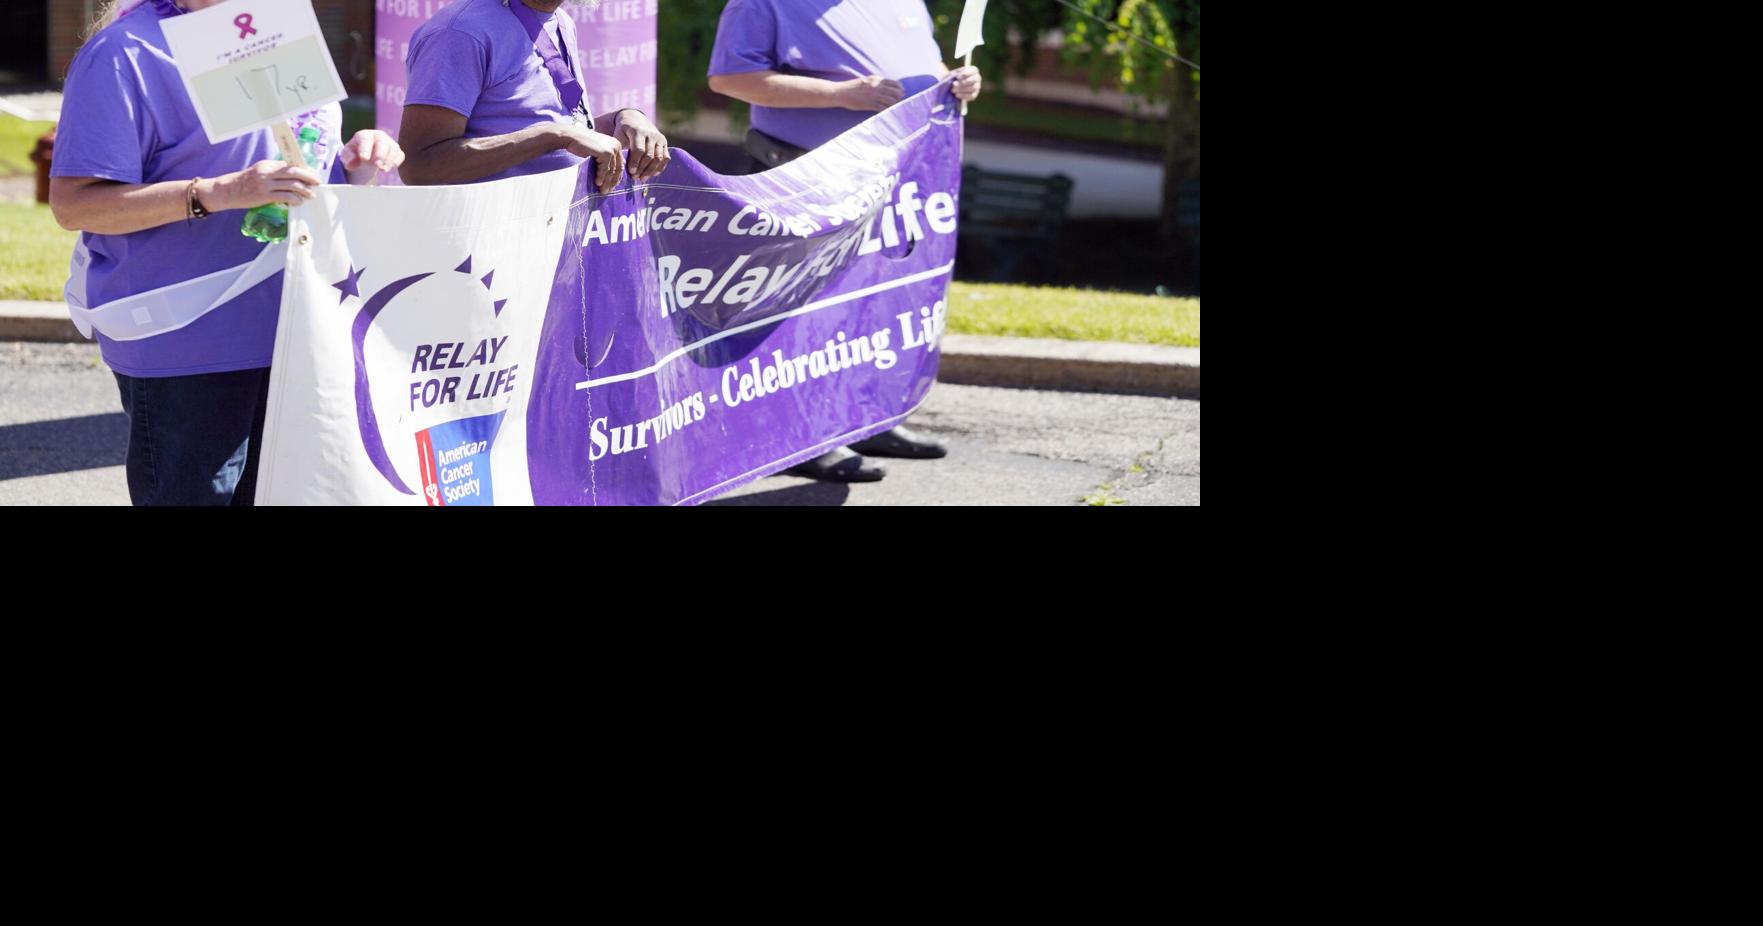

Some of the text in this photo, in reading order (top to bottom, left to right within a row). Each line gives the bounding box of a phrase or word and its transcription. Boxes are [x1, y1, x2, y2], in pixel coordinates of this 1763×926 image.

[602, 0, 641, 22] LIFE
[857, 181, 957, 257] Life
[411, 335, 509, 374] RELAY
[721, 327, 898, 408] Celebrating
[896, 300, 948, 352] Lif
[410, 364, 519, 412] FOR LIFE
[438, 440, 488, 467] American
[441, 461, 474, 485] Cancer
[444, 478, 480, 504] Society
